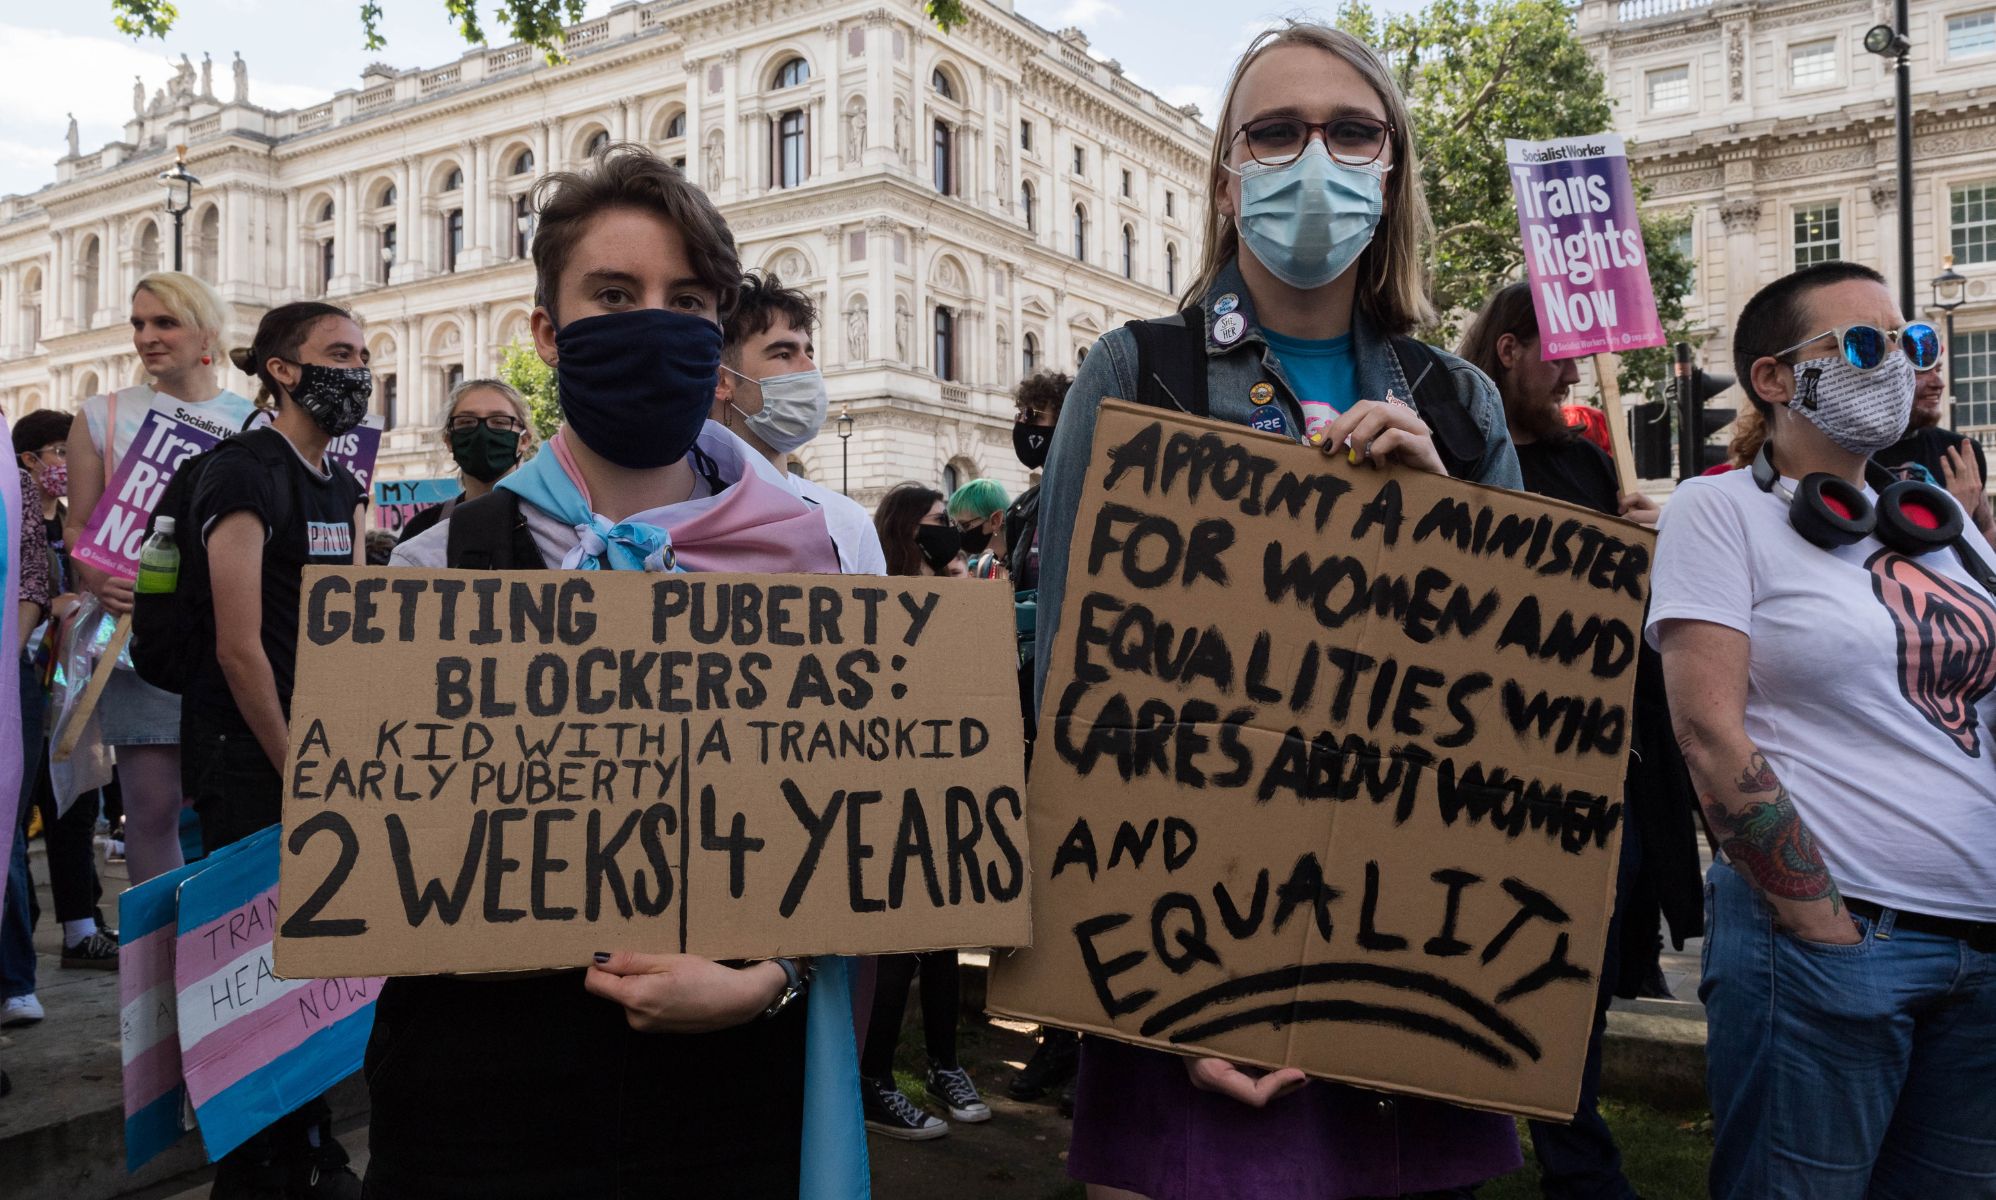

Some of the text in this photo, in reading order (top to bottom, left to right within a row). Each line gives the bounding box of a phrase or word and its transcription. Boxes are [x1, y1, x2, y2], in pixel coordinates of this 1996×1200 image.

[1522, 144, 1606, 163] Socialist Worker
[1514, 166, 1611, 219] Trans
[1529, 219, 1642, 285] Rights
[1541, 281, 1618, 335] Now
[142, 414, 202, 471] Tra
[174, 407, 223, 438] Socialist
[382, 482, 420, 502] MY
[1102, 421, 1650, 602] APPOINT A MINISTER
[307, 575, 940, 647] GETTING PUBERTY
[1087, 501, 1635, 679] FOR WOMEN AND
[436, 646, 907, 719] BLOCKERS AS:
[1075, 590, 1625, 756] EQUALITIES WHO
[297, 719, 664, 761] A KID WITH
[697, 715, 731, 765] A
[1054, 680, 1624, 856] CARES ABOUT WOMEN
[292, 755, 680, 804] EARLY PUBERTY
[280, 802, 677, 938] 2 WEEKS
[700, 778, 1023, 919] 4 YEARS
[1051, 816, 1198, 883] AND
[204, 896, 278, 960] TRAN
[1073, 851, 1592, 1020] EQUALITY
[299, 976, 367, 1029] NOW
